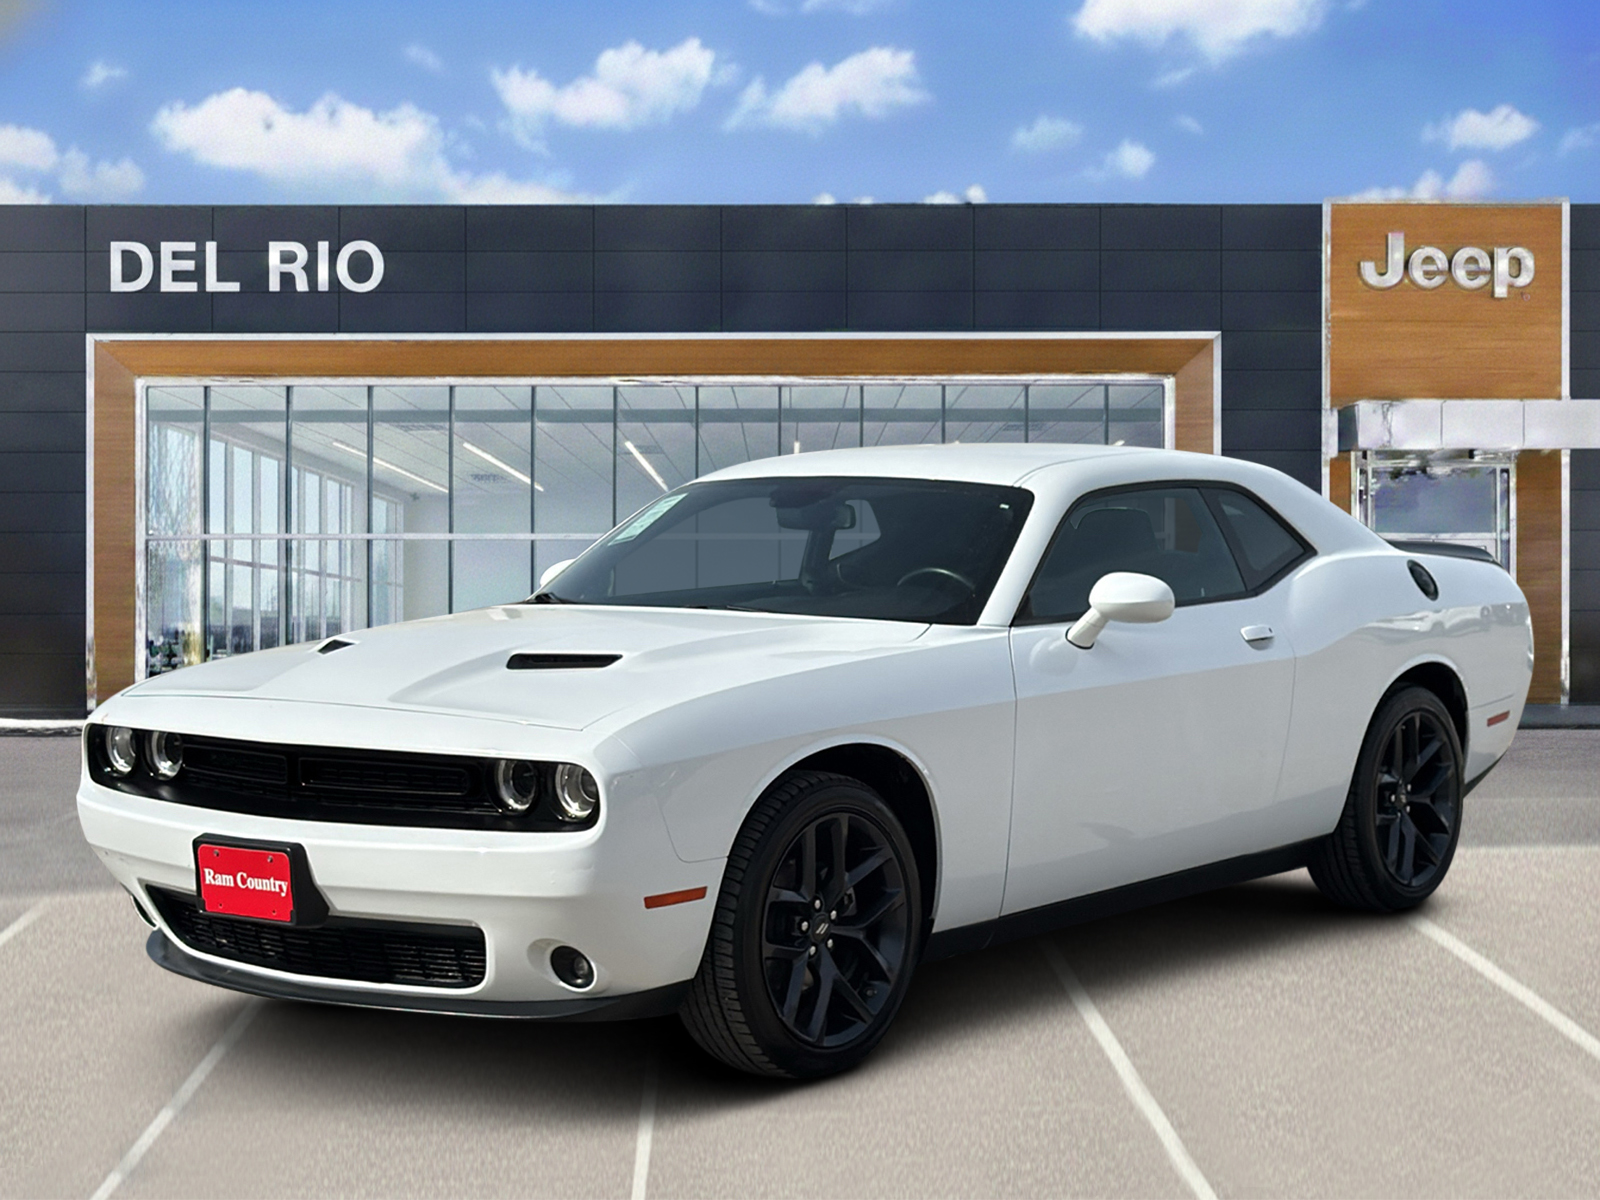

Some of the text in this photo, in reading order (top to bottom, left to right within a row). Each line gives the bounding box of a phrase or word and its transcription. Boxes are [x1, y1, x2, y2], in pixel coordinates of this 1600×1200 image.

[110, 240, 384, 293] DEL RIO
[1360, 231, 1535, 298] Jeep
[204, 867, 288, 897] Ram Country
